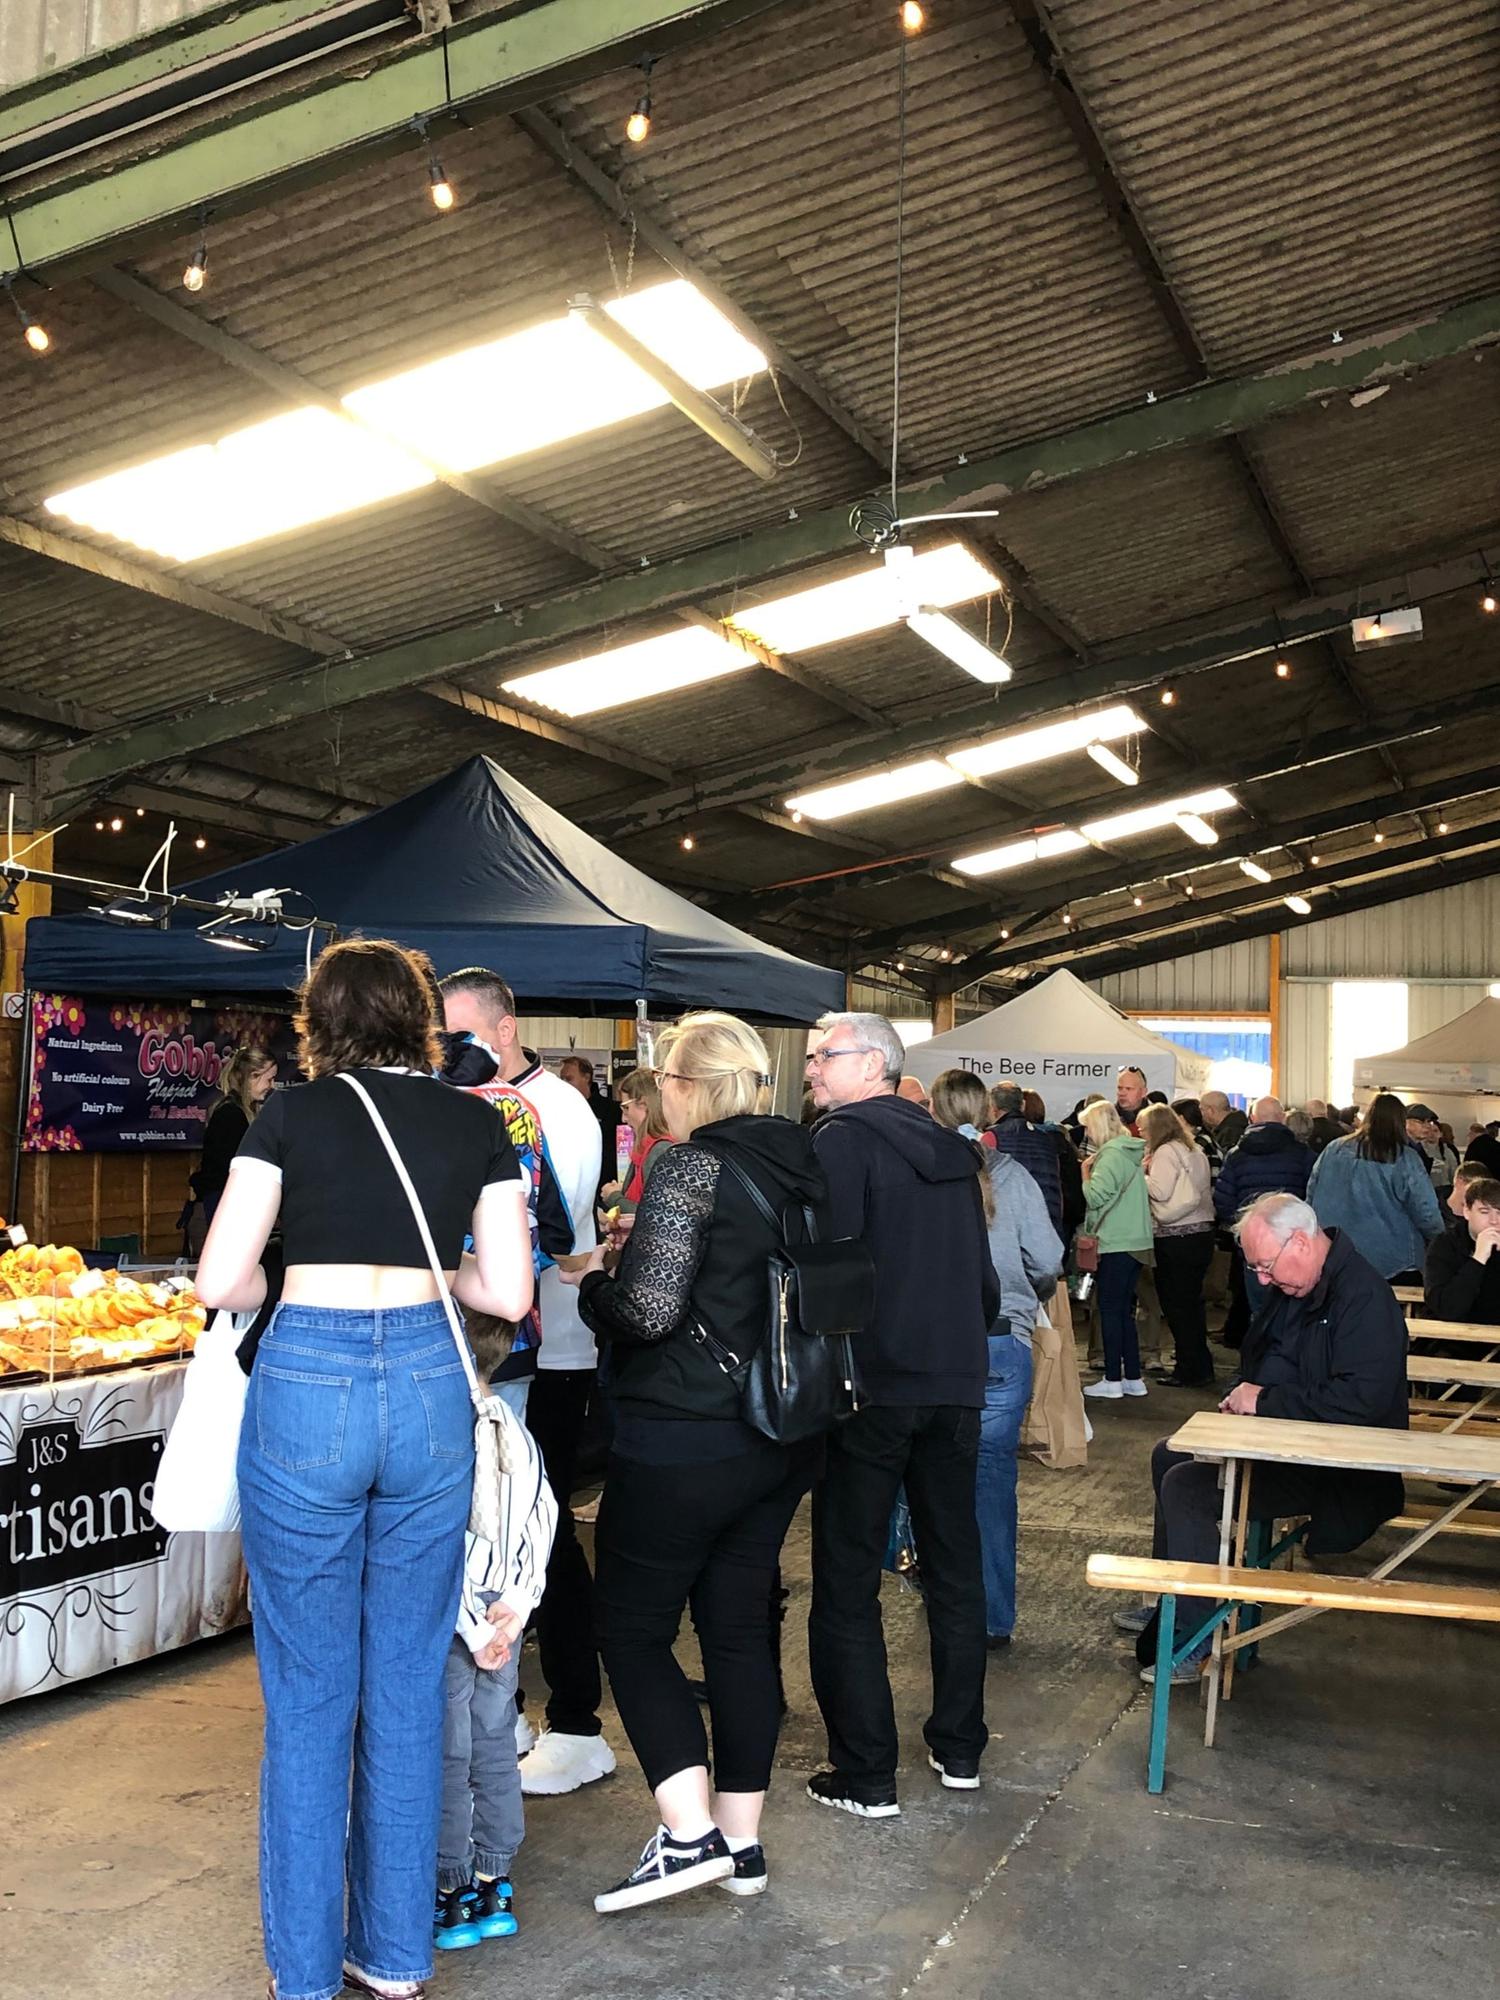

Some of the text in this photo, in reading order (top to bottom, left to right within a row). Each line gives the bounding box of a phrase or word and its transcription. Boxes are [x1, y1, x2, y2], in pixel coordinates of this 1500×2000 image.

[47, 1037, 123, 1053] Natural Ingredients
[958, 1057, 1111, 1077] The Bee Farmer
[52, 1072, 131, 1085] No artificial colours
[146, 1077, 200, 1103] Flapjack
[82, 1102, 124, 1115] Dairy Free
[27, 1433, 69, 1474] J&S
[0, 1481, 158, 1564] tisans
